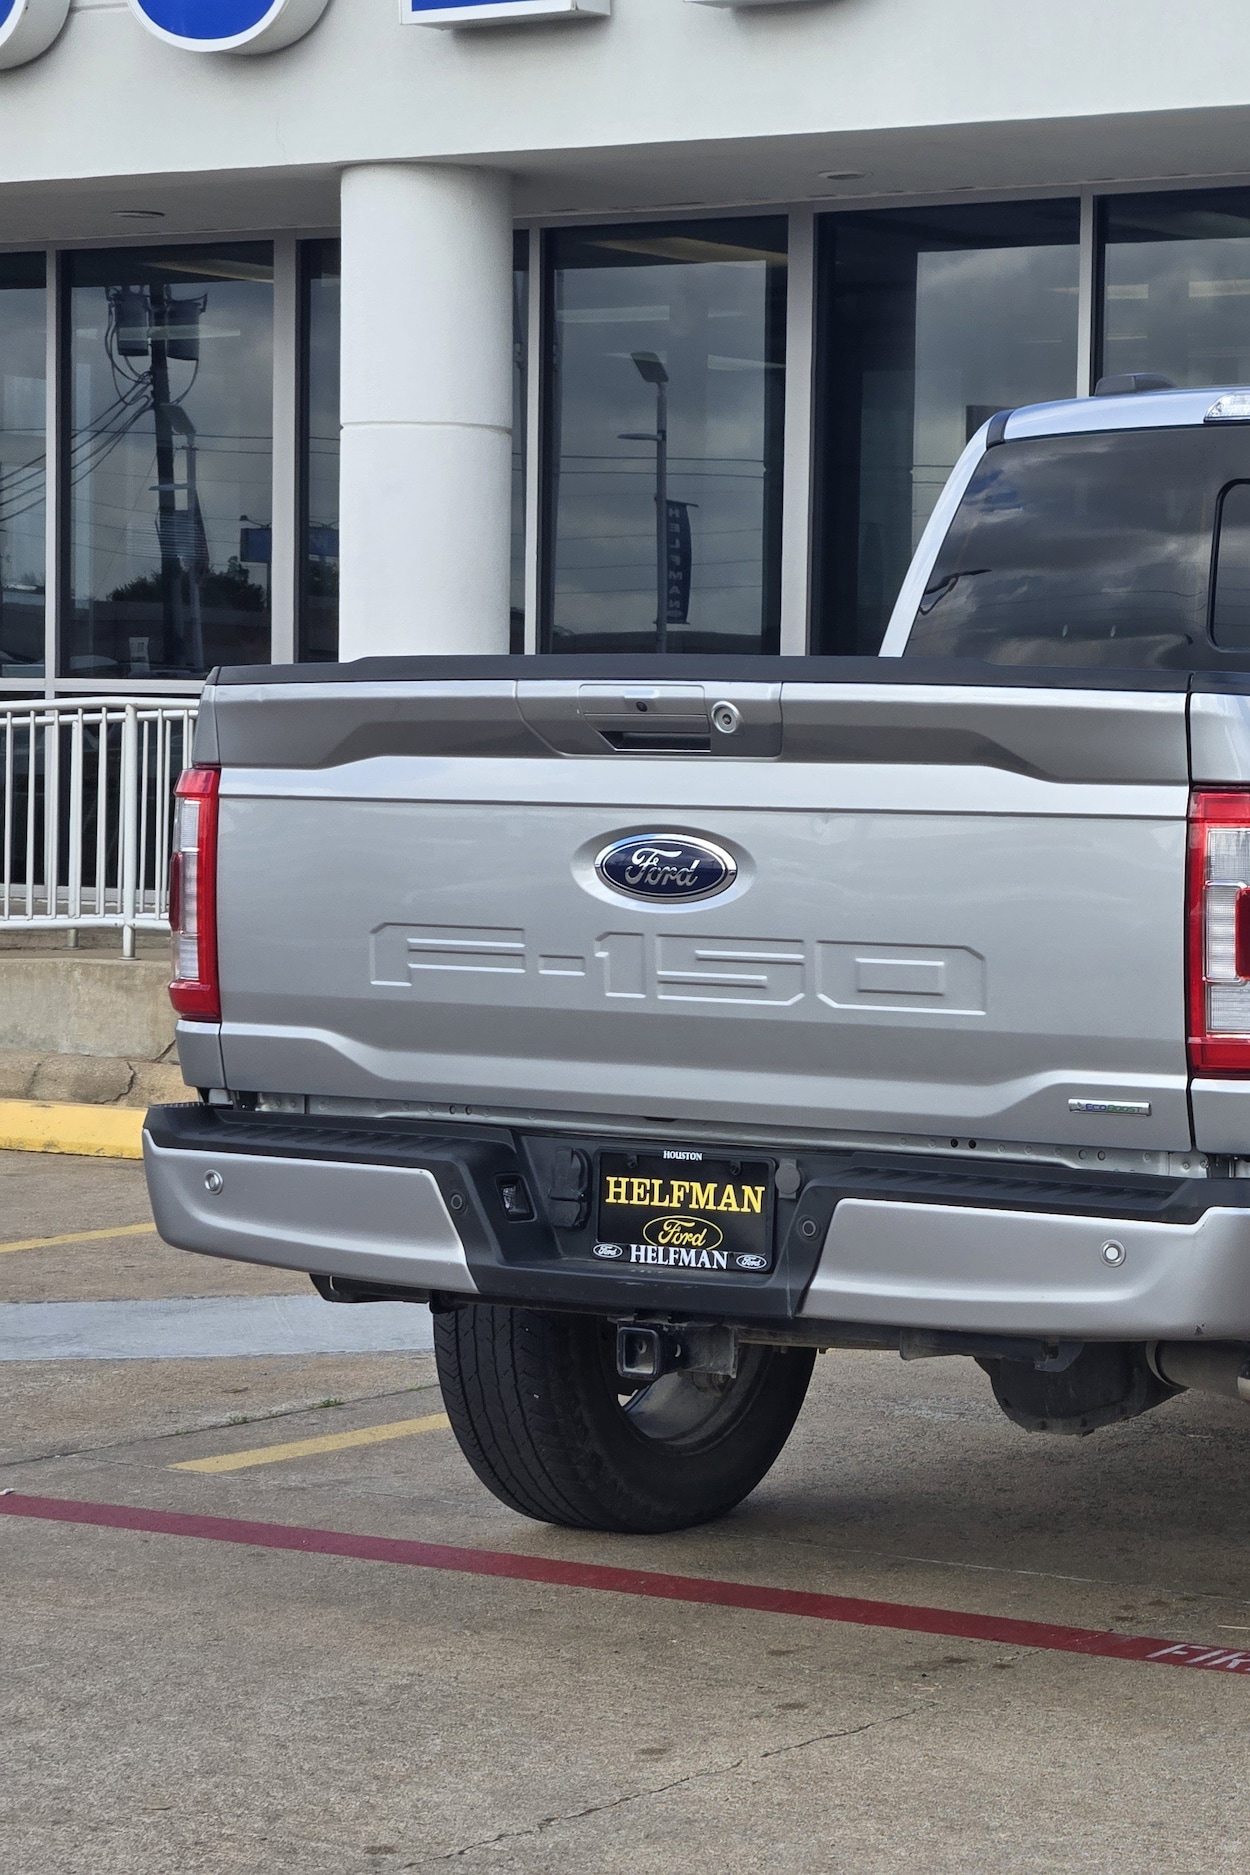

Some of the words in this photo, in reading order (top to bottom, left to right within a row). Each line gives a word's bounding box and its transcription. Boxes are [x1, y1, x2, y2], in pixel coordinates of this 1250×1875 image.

[625, 847, 700, 887] Ford
[369, 921, 987, 1016] F-150
[663, 1150, 703, 1161] HOUSTON
[605, 1176, 766, 1213] HELFMAN
[657, 1219, 708, 1247] Ford
[630, 1244, 729, 1270] HELFMAN
